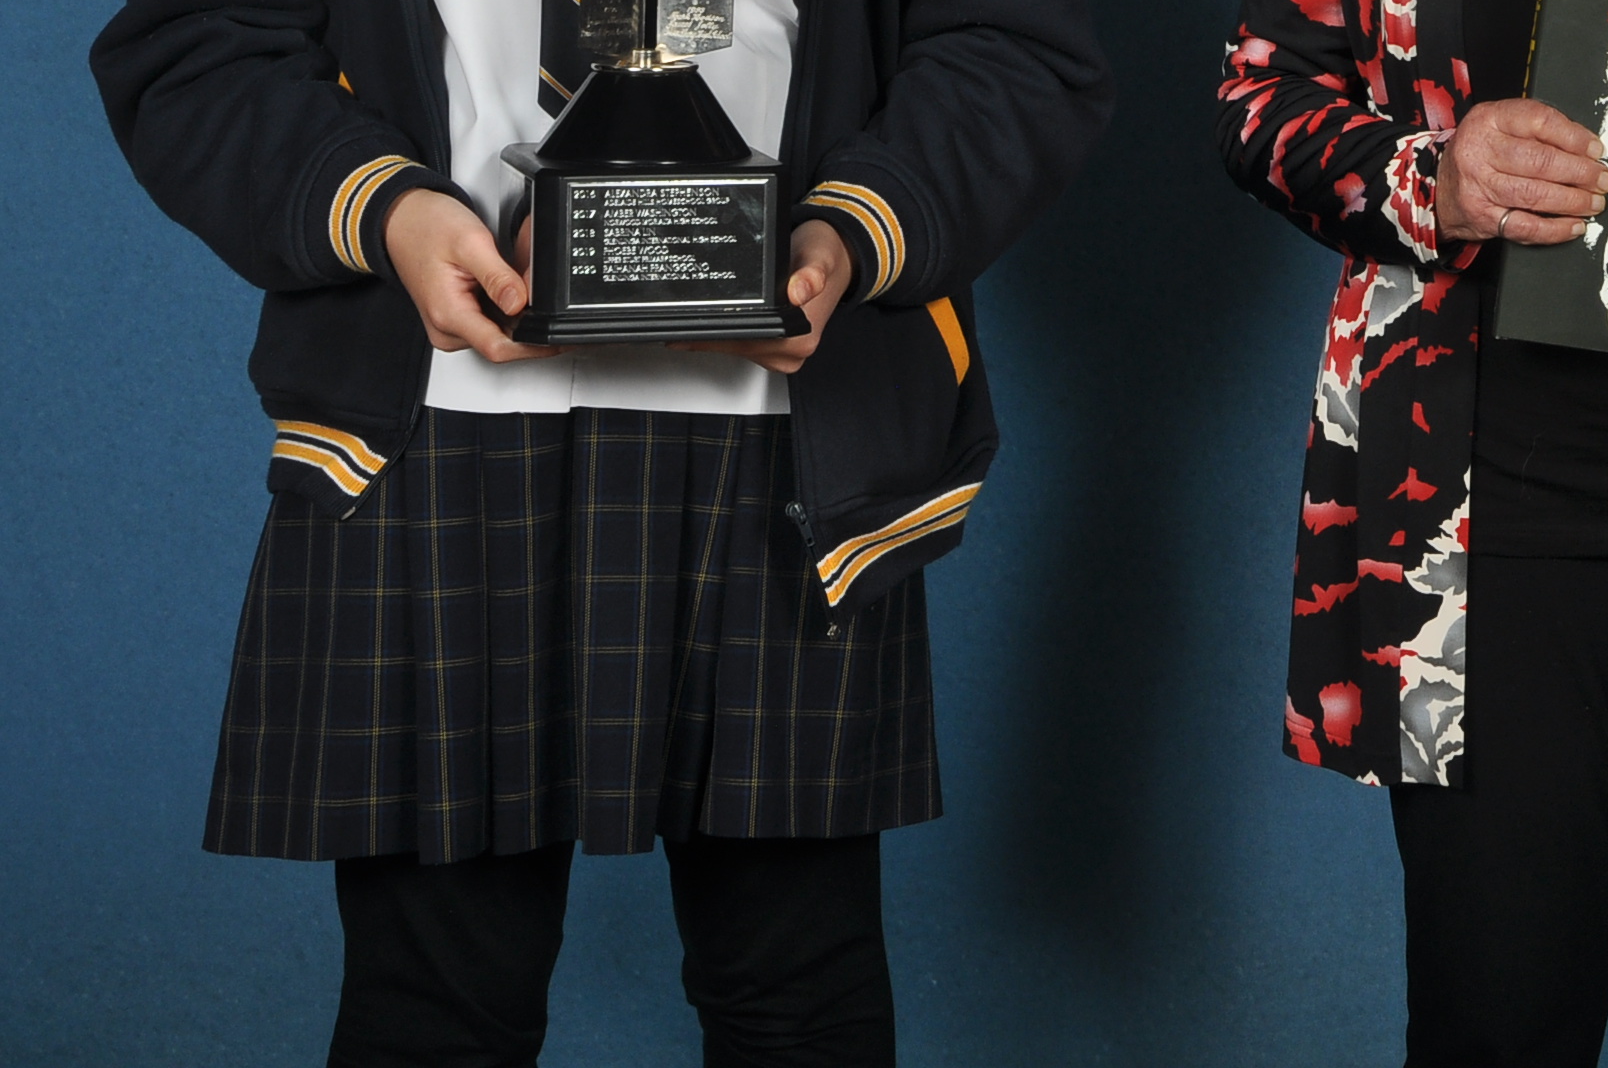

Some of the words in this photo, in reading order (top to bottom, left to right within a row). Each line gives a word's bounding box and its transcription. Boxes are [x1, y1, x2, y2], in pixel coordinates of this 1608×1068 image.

[573, 189, 597, 200] 2016
[604, 188, 658, 199] ALEXANDRA
[660, 187, 720, 198] STEPHENSON
[572, 209, 597, 220] 2017
[604, 208, 634, 219] AMBER
[636, 207, 698, 218] WASHINGTON
[572, 228, 596, 239] 2018
[603, 227, 641, 238] SABRINA
[642, 226, 657, 237] LIN
[572, 247, 596, 257] 2019
[603, 246, 637, 256] PHOEBE
[638, 244, 670, 255] WOOD
[572, 264, 597, 275] 2020
